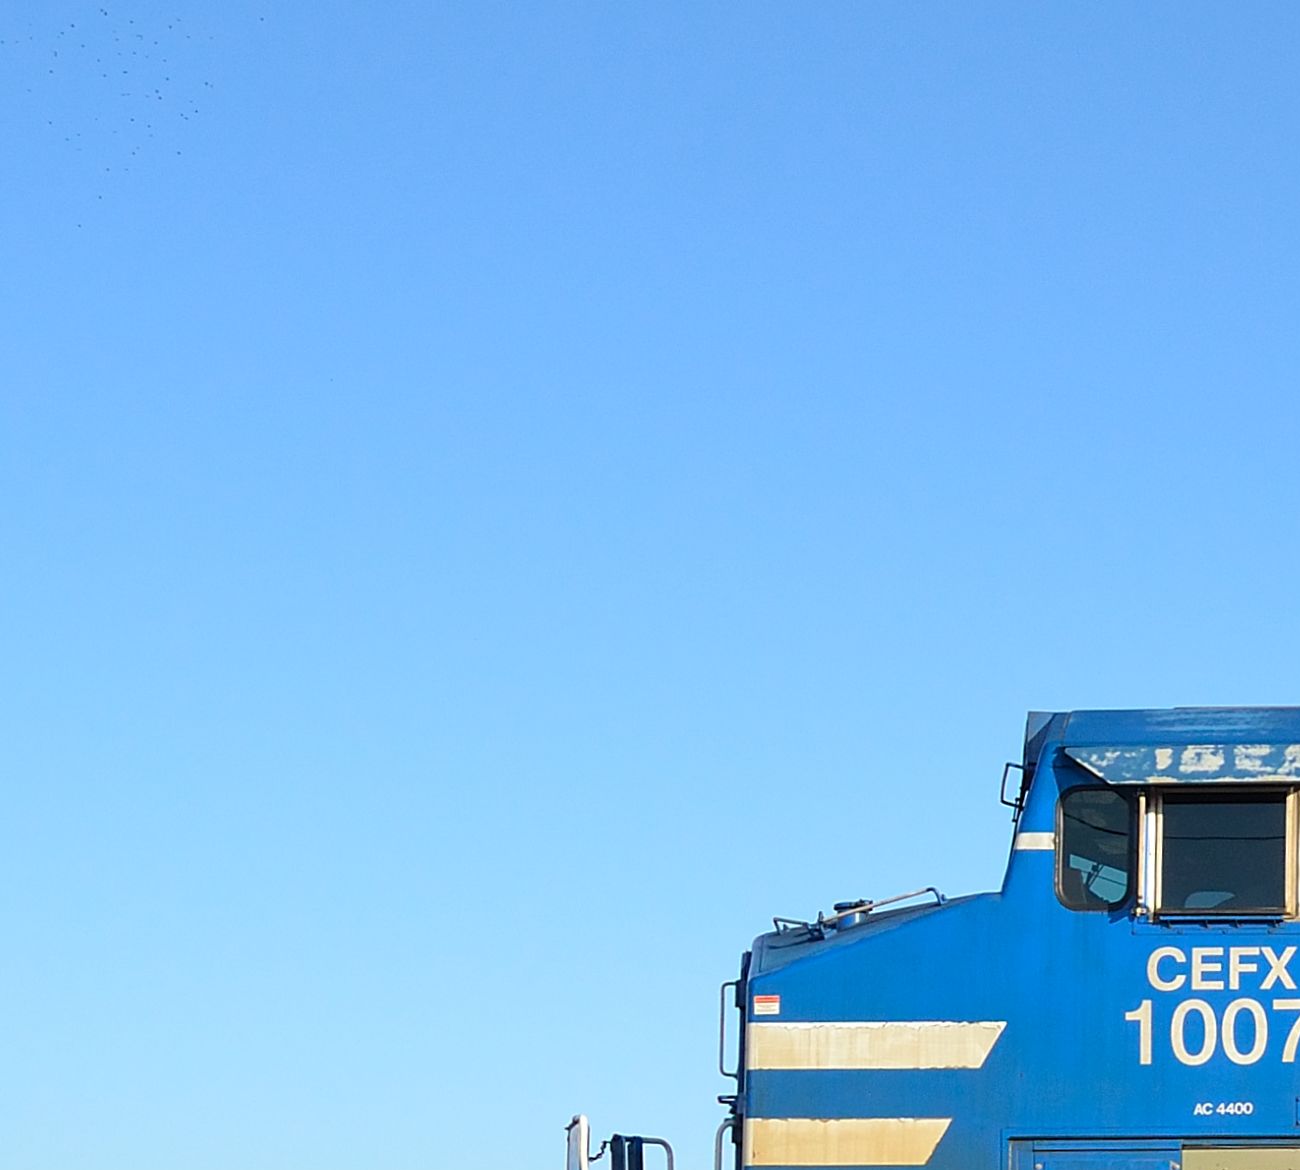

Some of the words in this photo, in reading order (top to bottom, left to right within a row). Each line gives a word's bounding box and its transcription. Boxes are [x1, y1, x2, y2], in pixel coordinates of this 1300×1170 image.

[1146, 946, 1298, 992] CEFX
[1193, 1102, 1214, 1116] AC
[1216, 1102, 1254, 1115] 4400
